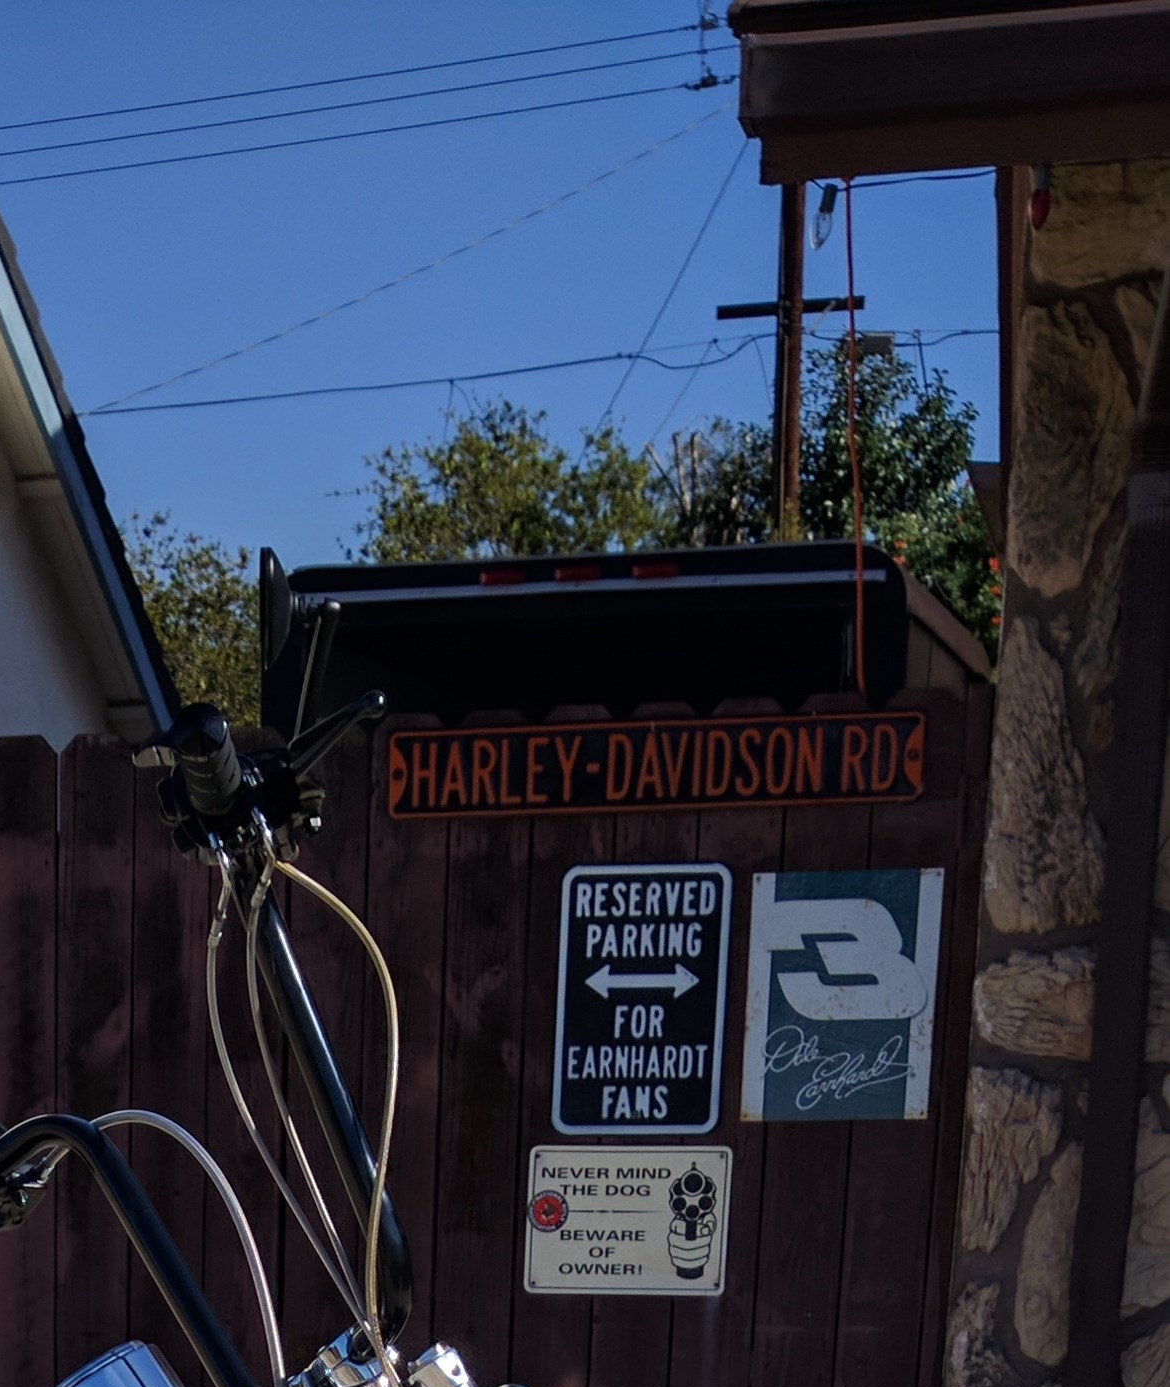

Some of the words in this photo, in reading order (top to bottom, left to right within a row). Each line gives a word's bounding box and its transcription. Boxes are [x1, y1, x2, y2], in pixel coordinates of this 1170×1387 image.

[411, 725, 823, 808] HARLEY-DAVIDSON
[840, 724, 900, 792] RD
[575, 880, 717, 918] RESERVED
[585, 922, 703, 958] PARKING
[613, 1004, 665, 1039] FOR
[566, 1044, 709, 1080] EARNHARDT
[601, 1084, 668, 1120] FANS
[541, 1166, 610, 1180] NEVER
[616, 1167, 671, 1180] MIND
[559, 1183, 599, 1197] THE
[605, 1184, 651, 1197] DOG
[559, 1229, 647, 1242] BEWARE
[588, 1246, 617, 1259] OF
[558, 1263, 643, 1276] OWNER!
